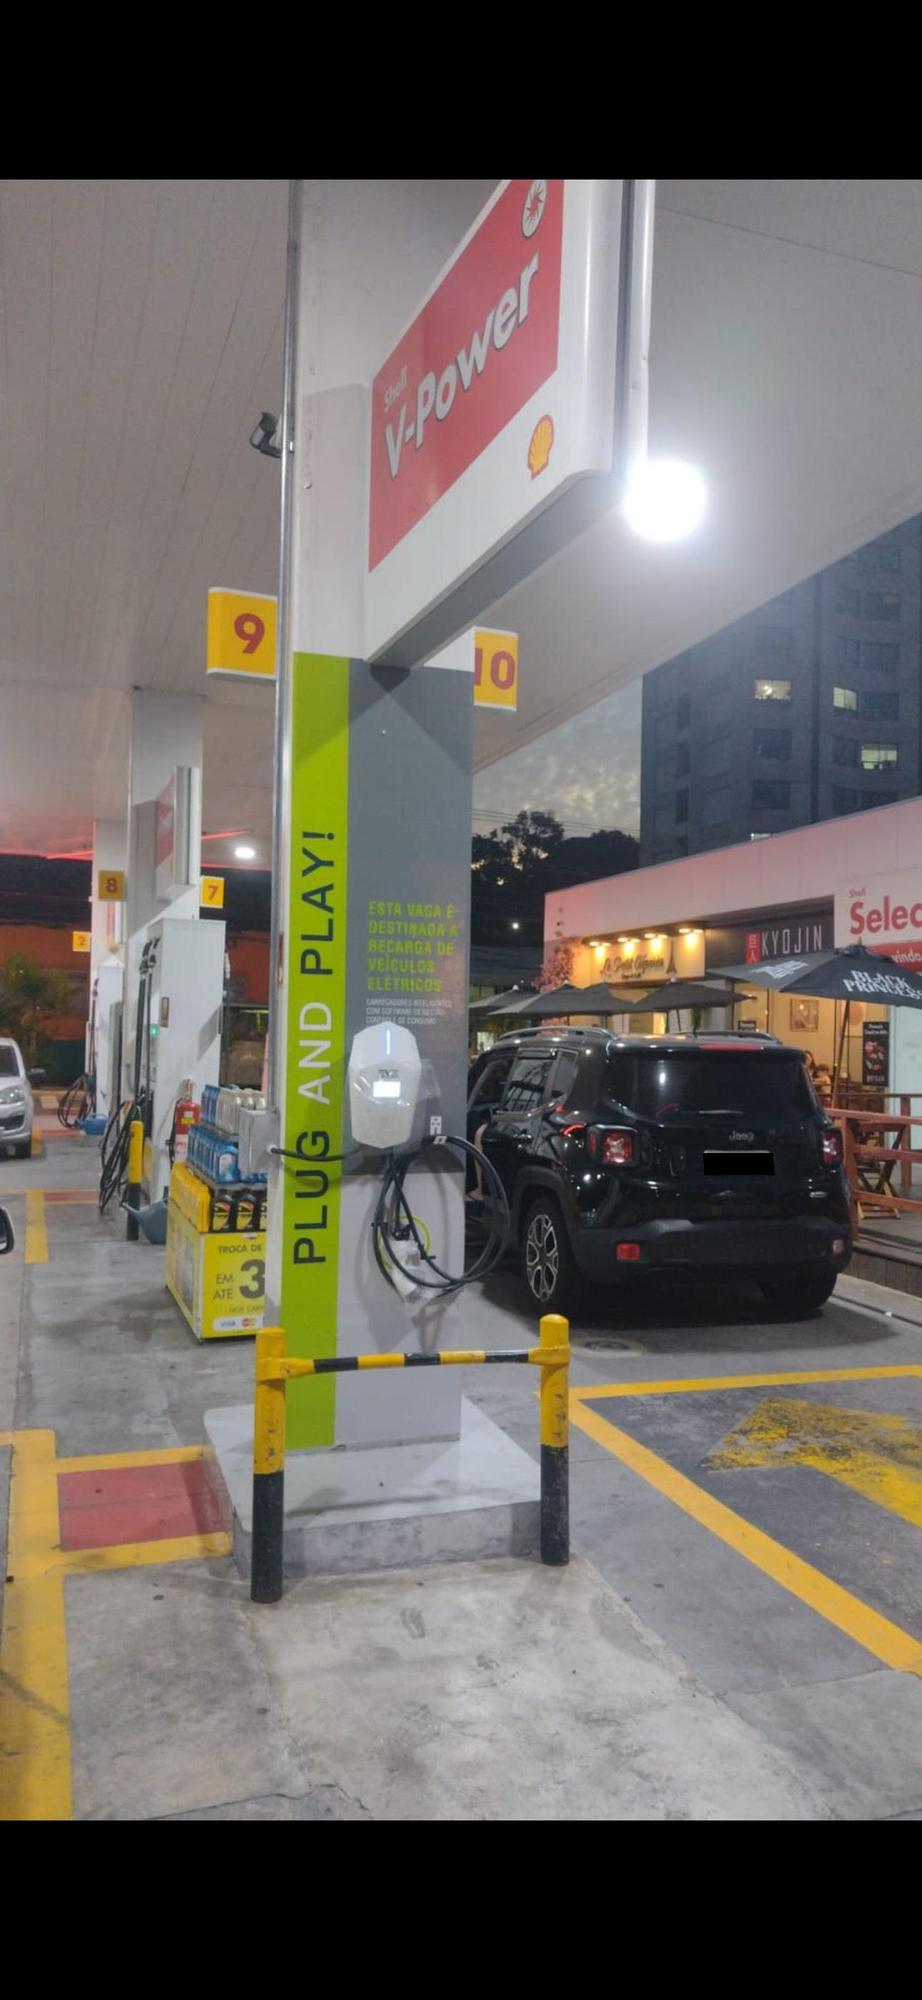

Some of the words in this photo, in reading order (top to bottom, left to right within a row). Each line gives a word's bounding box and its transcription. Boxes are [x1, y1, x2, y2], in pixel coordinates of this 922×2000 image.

[383, 252, 539, 480] V-Power
[234, 613, 265, 655] 9
[474, 648, 516, 691] 10
[106, 877, 118, 894] 8
[207, 884, 219, 902] 7
[300, 831, 335, 976] PLAY!
[367, 900, 402, 916] ESTA
[406, 903, 442, 918] VAGA
[849, 895, 922, 935] Selec
[436, 942, 454, 957] DE
[761, 925, 822, 957] KYOJIN
[299, 1001, 333, 1106] AND
[729, 1130, 755, 1143] Jeep
[292, 1128, 331, 1266] PLUG
[218, 1245, 247, 1255] TROCA
[216, 1273, 234, 1285] EM
[240, 1259, 265, 1299] 3
